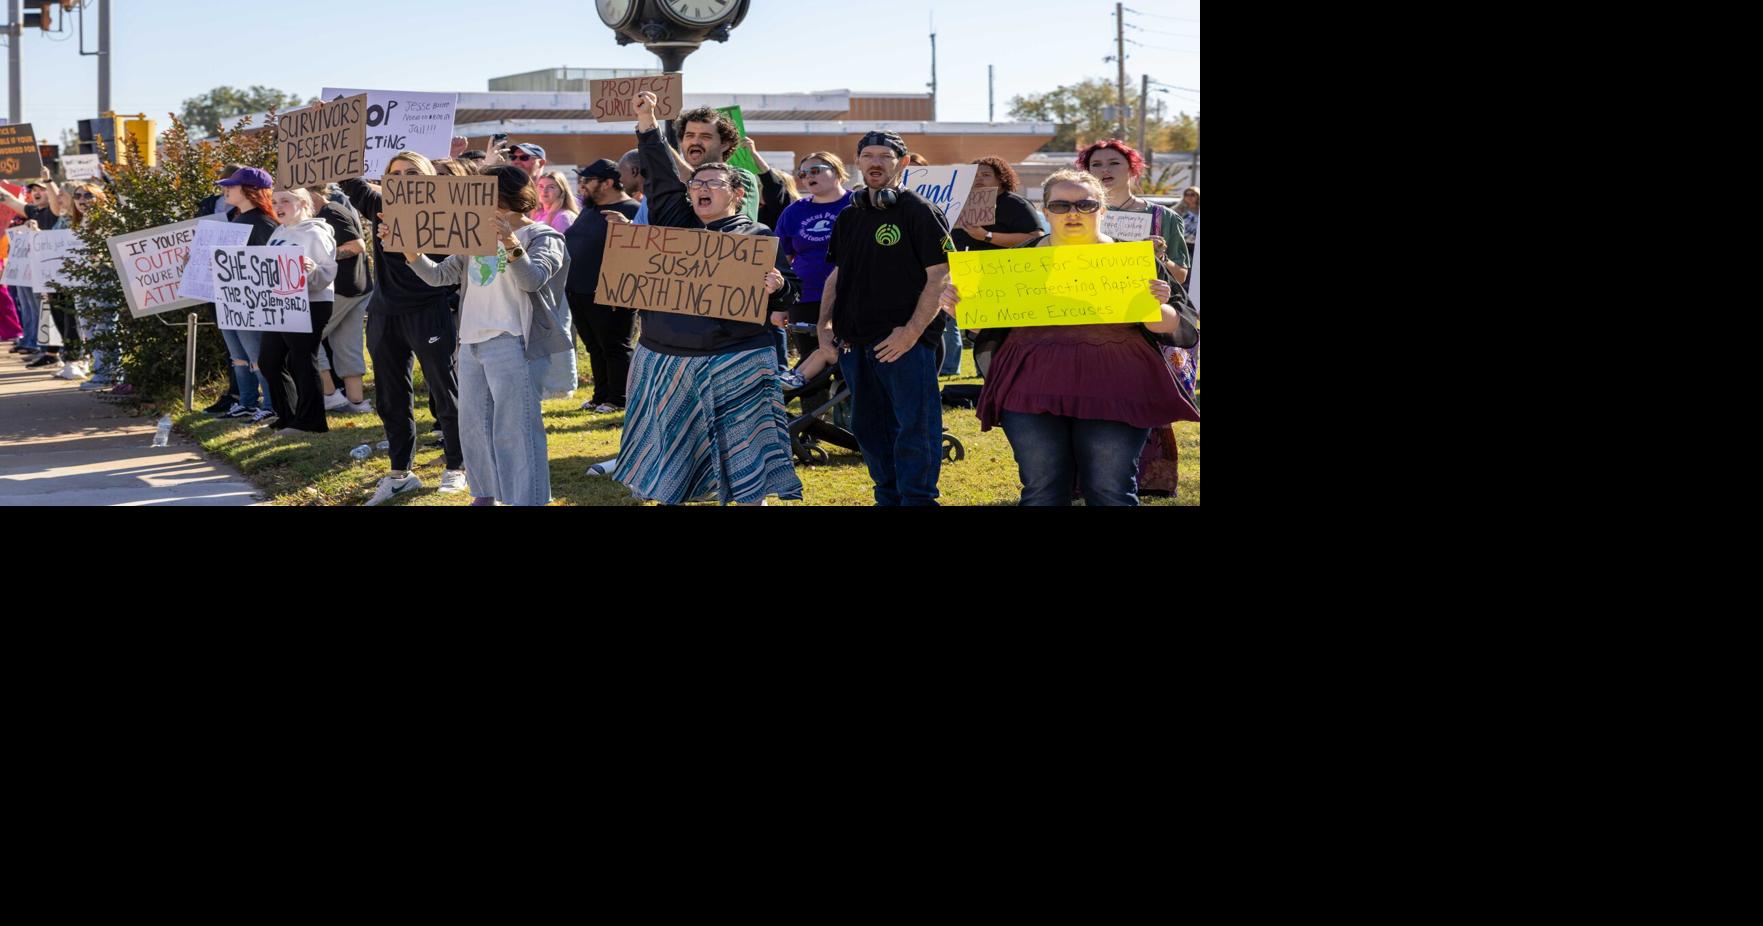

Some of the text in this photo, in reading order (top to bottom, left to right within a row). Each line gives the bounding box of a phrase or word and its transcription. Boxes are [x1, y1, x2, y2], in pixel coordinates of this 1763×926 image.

[601, 75, 675, 98] PROTECT
[278, 99, 361, 143] SURVIVORS
[366, 99, 399, 128] OP
[595, 95, 672, 119] SURVIRS
[286, 127, 351, 164] DESERVE
[284, 149, 359, 190] JUSTICE
[385, 178, 495, 207] SAFER WITH
[391, 210, 482, 249] A BEAR
[126, 239, 148, 257] IF
[608, 223, 769, 266] FIRE JUDGE
[645, 253, 720, 278] SUSAN
[957, 258, 1034, 277] Justice
[1077, 252, 1152, 270] Survivors
[602, 272, 766, 319] WORTHINGTON
[961, 285, 1006, 303] Stop
[1016, 278, 1098, 299] Protecting
[964, 303, 1115, 326] No More Excuses
